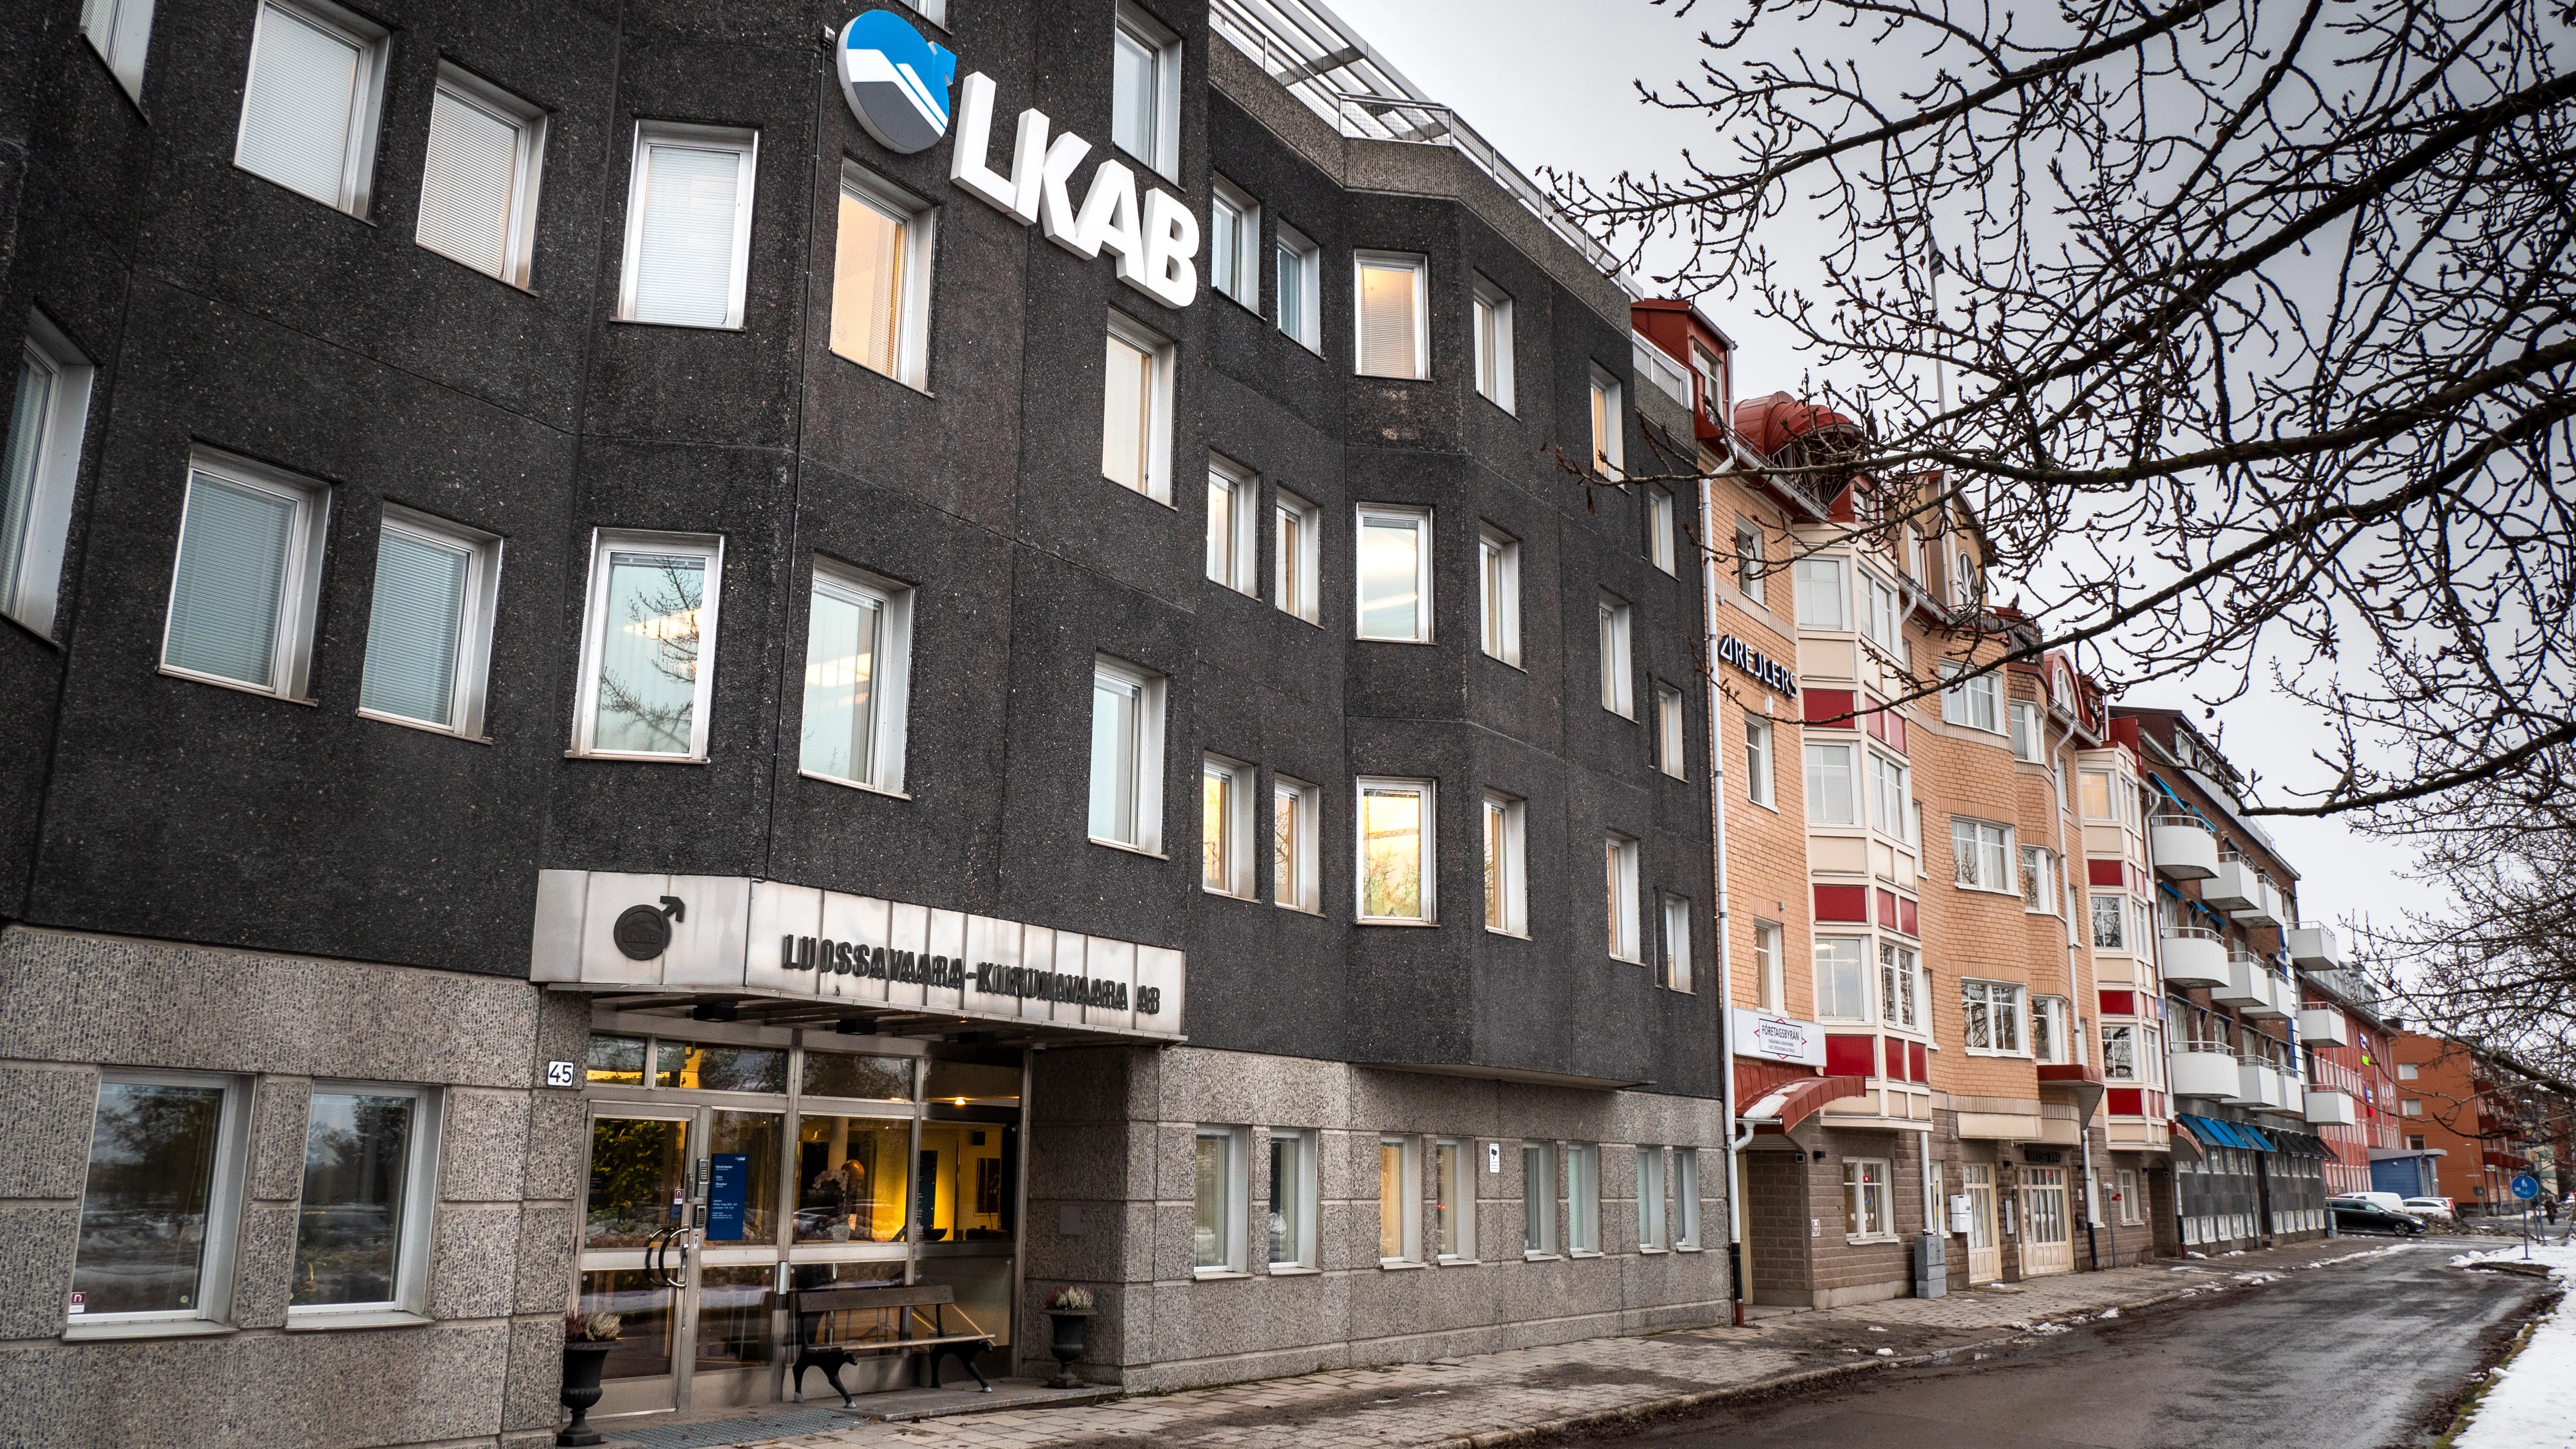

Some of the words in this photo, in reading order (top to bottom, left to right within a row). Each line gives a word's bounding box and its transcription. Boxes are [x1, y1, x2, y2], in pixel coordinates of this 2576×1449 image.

[950, 71, 1200, 310] LKAB
[1731, 637, 1797, 699] REJLERS
[1137, 984, 1160, 1014] AB
[1762, 1023, 1799, 1041] FÖRETAGSBYRÅN
[549, 1064, 572, 1083] 45
